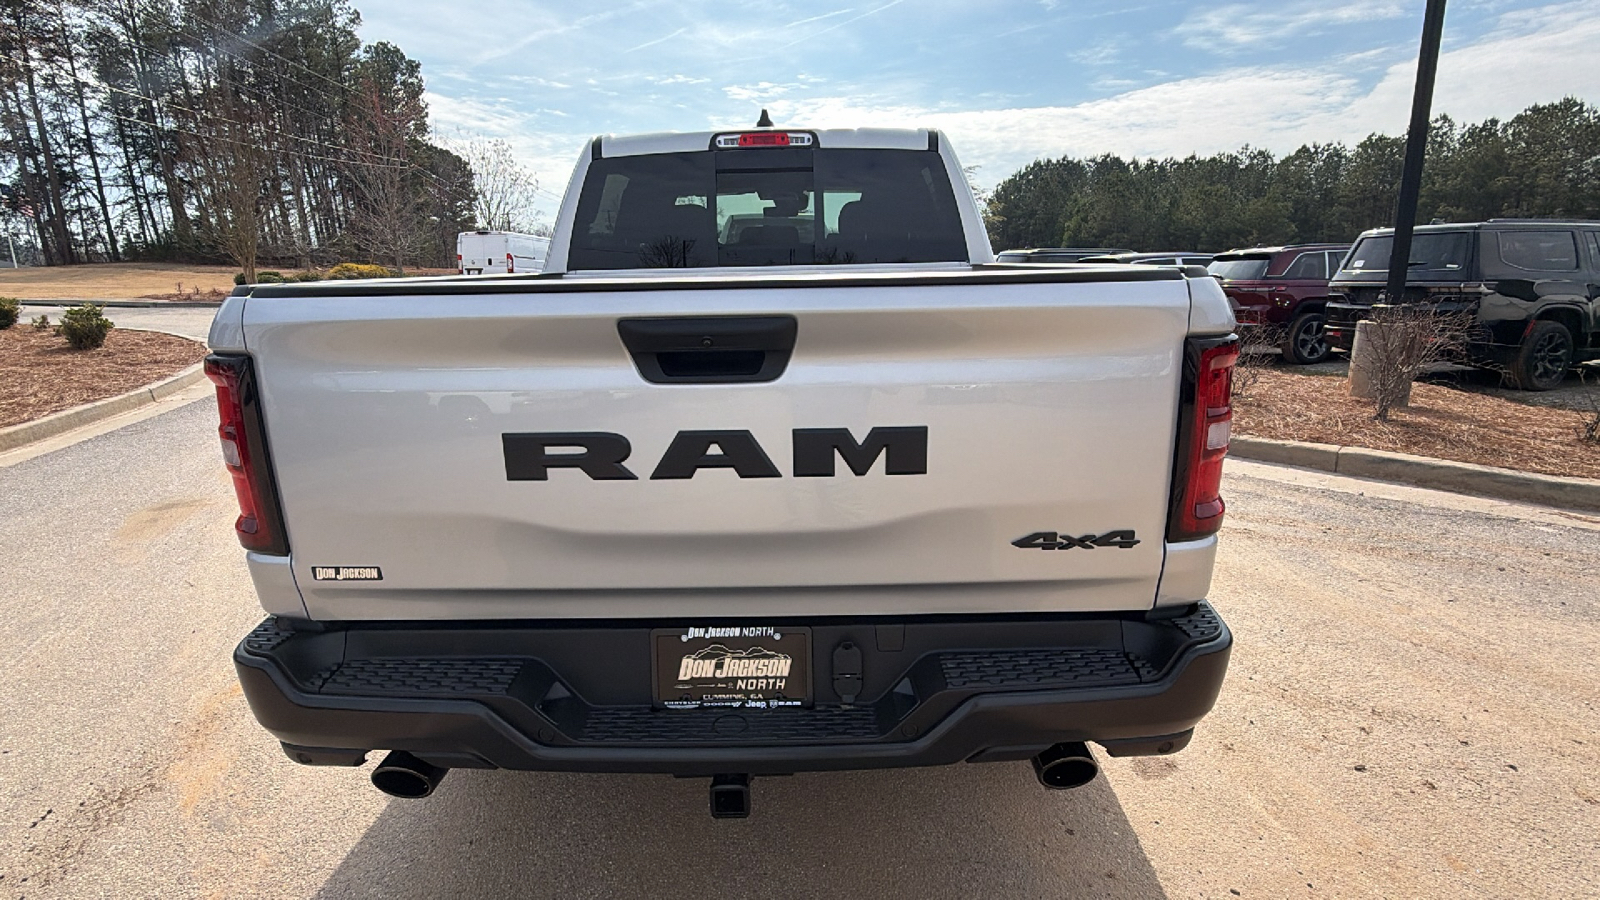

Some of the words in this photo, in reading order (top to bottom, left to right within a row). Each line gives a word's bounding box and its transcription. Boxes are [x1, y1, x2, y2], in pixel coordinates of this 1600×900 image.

[501, 425, 928, 481] RAM
[316, 567, 336, 580] DON
[336, 567, 379, 580] JACKSON
[687, 626, 706, 639] DON
[705, 626, 741, 639] JACKSON
[741, 626, 774, 637] NORTH
[677, 657, 717, 681] DON
[714, 655, 793, 678] JACKSON
[736, 678, 786, 691] NORTH
[744, 700, 767, 709] Jeep
